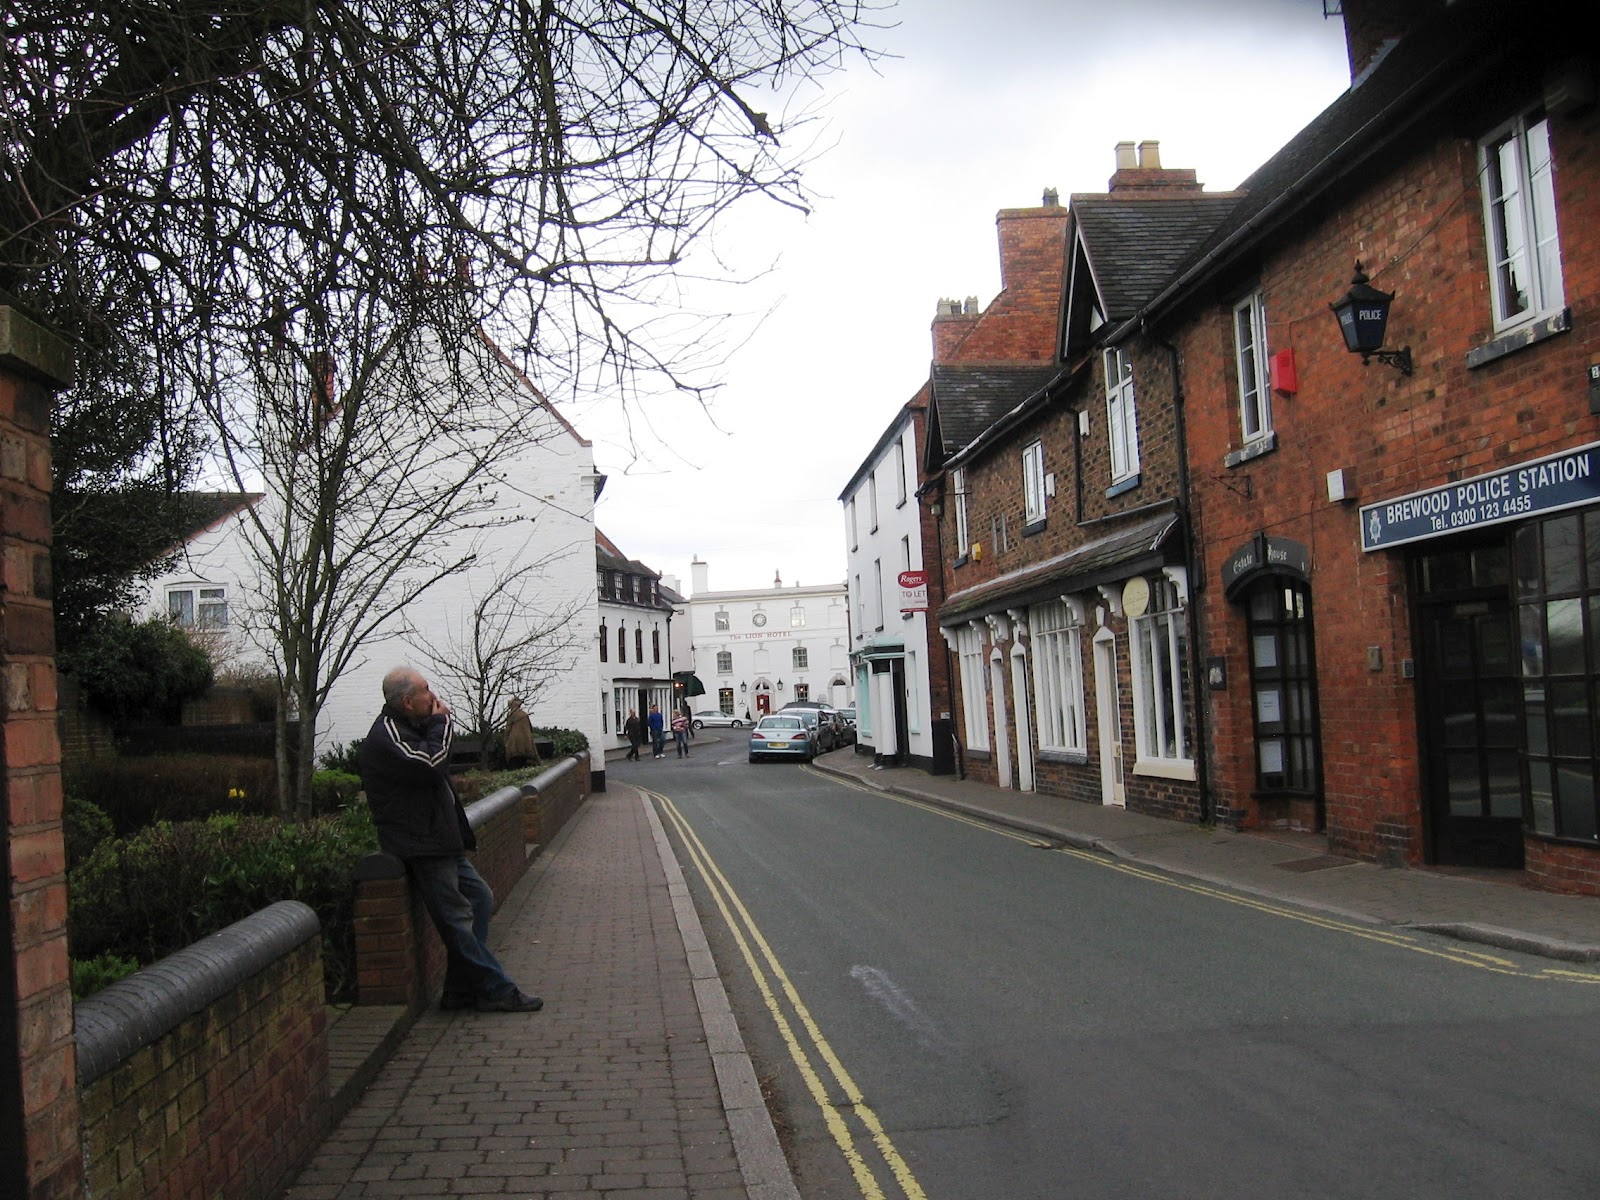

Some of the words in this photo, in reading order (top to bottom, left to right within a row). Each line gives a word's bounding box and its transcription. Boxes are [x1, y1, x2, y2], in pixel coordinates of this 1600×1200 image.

[1340, 312, 1353, 325] POLICE
[1359, 309, 1382, 321] POLICE
[1387, 493, 1450, 524] BREWOOD
[1457, 475, 1511, 507] POLICE
[1518, 453, 1590, 493] STATION
[1430, 515, 1449, 531] Tel.
[1450, 510, 1477, 527] 0300
[1479, 504, 1500, 520] 123
[1502, 494, 1532, 514] 4455
[913, 590, 926, 598] LET
[745, 632, 763, 640] LION
